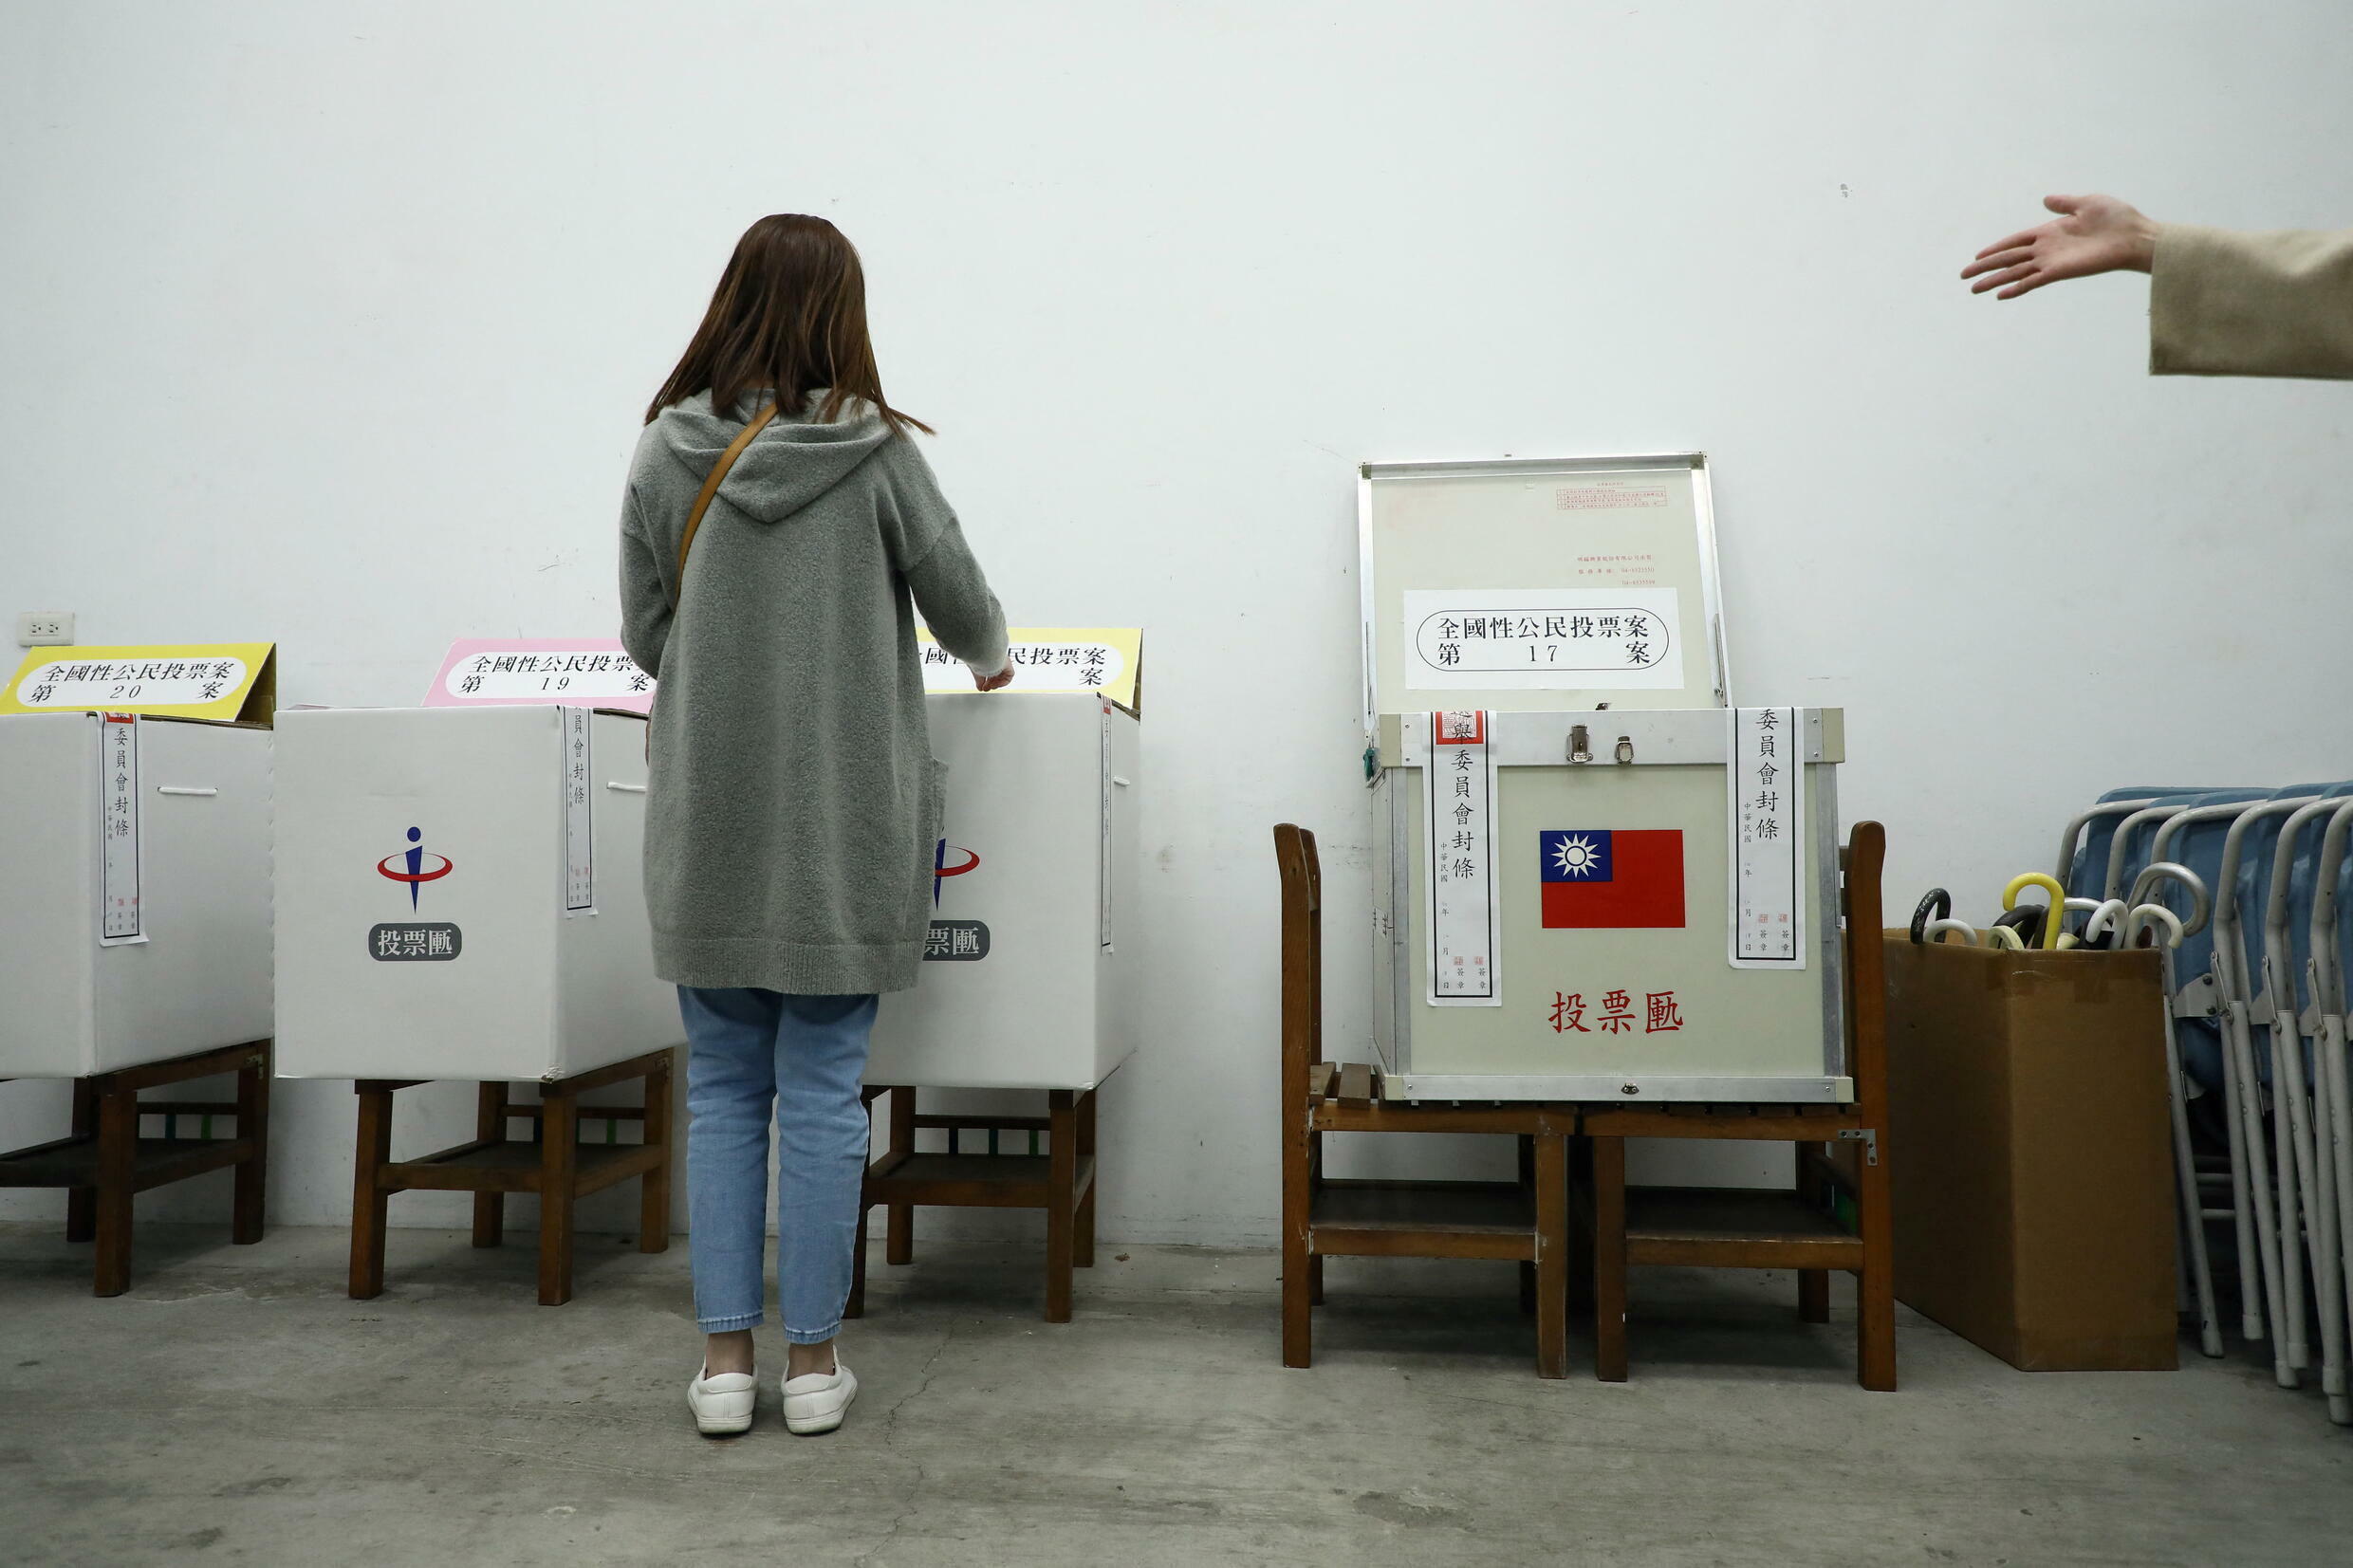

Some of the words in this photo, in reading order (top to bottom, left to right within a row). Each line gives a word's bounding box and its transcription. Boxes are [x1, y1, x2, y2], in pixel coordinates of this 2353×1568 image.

[1436, 615, 1649, 639] 全國性公民投票案
[468, 655, 641, 673] 全國性公民投票
[1437, 643, 1461, 666] 第
[1529, 645, 1558, 663] 17
[1625, 640, 1651, 665] 案
[42, 661, 235, 683] 全國性公民投票案
[457, 675, 486, 693] 第
[540, 676, 571, 691] 19
[626, 673, 652, 692] 案
[1078, 667, 1104, 686] 案
[29, 684, 57, 703] 第
[109, 685, 141, 699] 20
[197, 681, 223, 699] 案
[573, 706, 584, 805] 員會封條
[1755, 708, 1781, 840] 委員會封條
[1744, 802, 1752, 843] 中華民國
[378, 929, 454, 957] 投票匭
[925, 927, 980, 956] 票匭
[1547, 989, 1684, 1035] 投票匭
